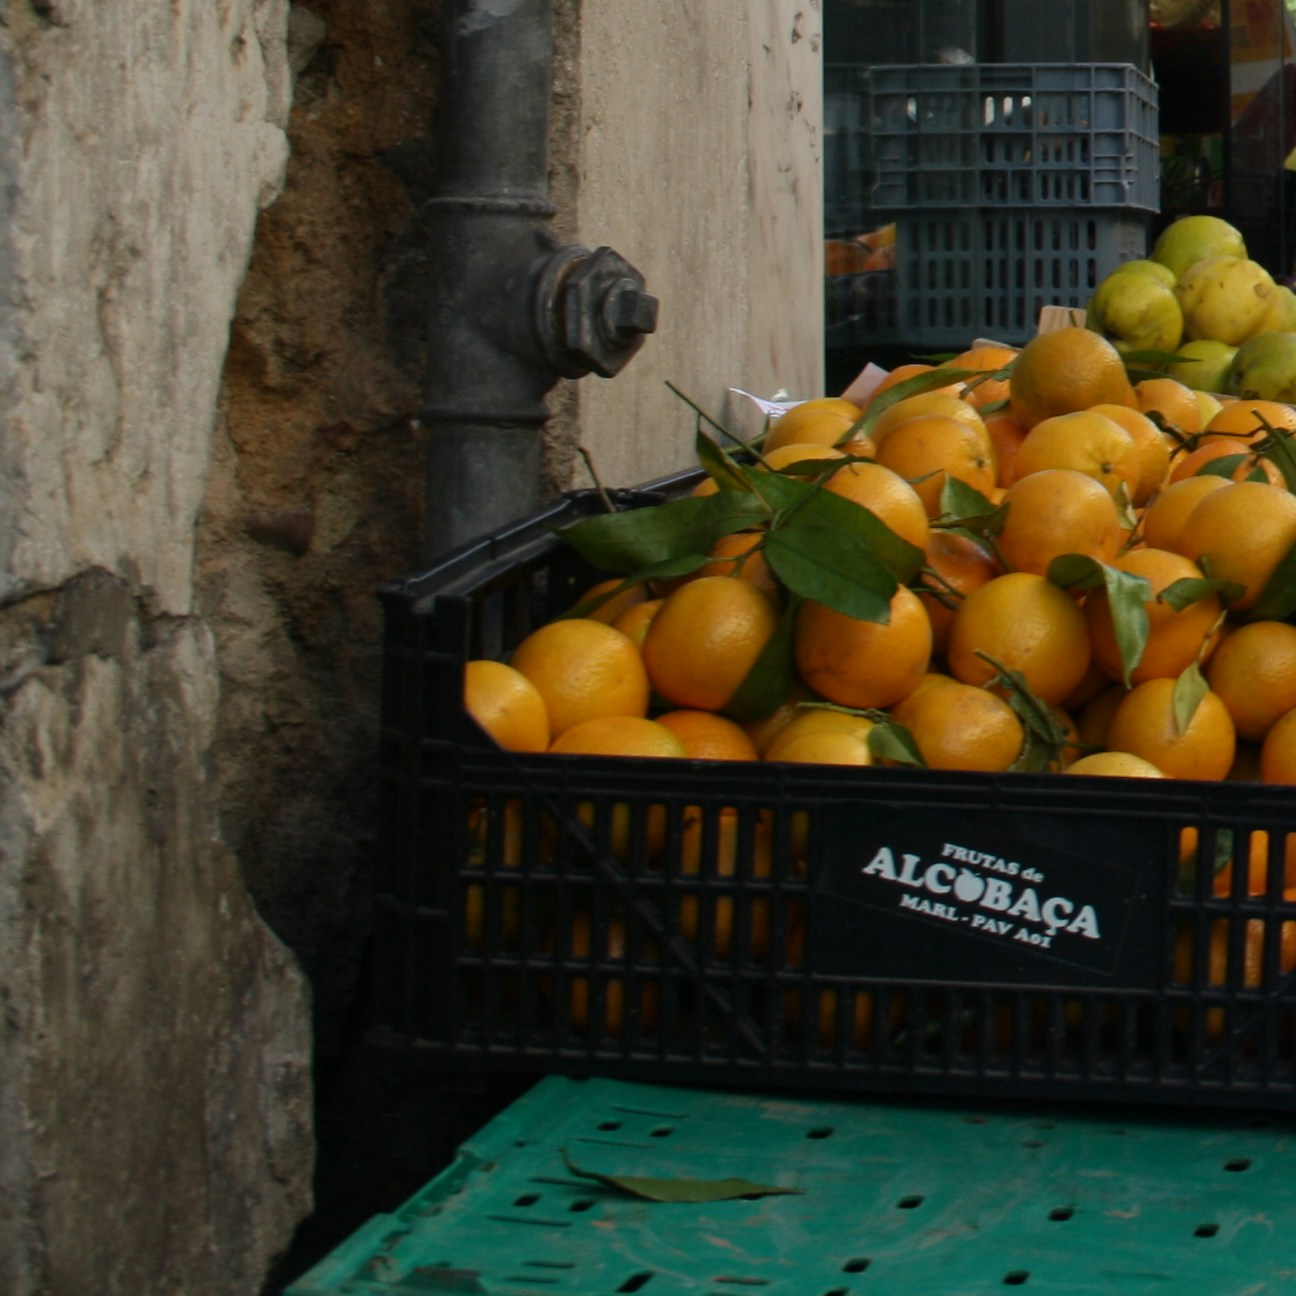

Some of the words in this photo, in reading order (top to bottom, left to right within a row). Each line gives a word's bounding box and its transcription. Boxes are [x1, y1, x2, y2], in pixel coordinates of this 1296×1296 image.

[941, 843, 1021, 878] FRUTAS
[1021, 866, 1045, 883] de
[862, 846, 1101, 939] ALCOBAÇA
[900, 893, 960, 922] MARL
[971, 913, 1014, 936] PAV
